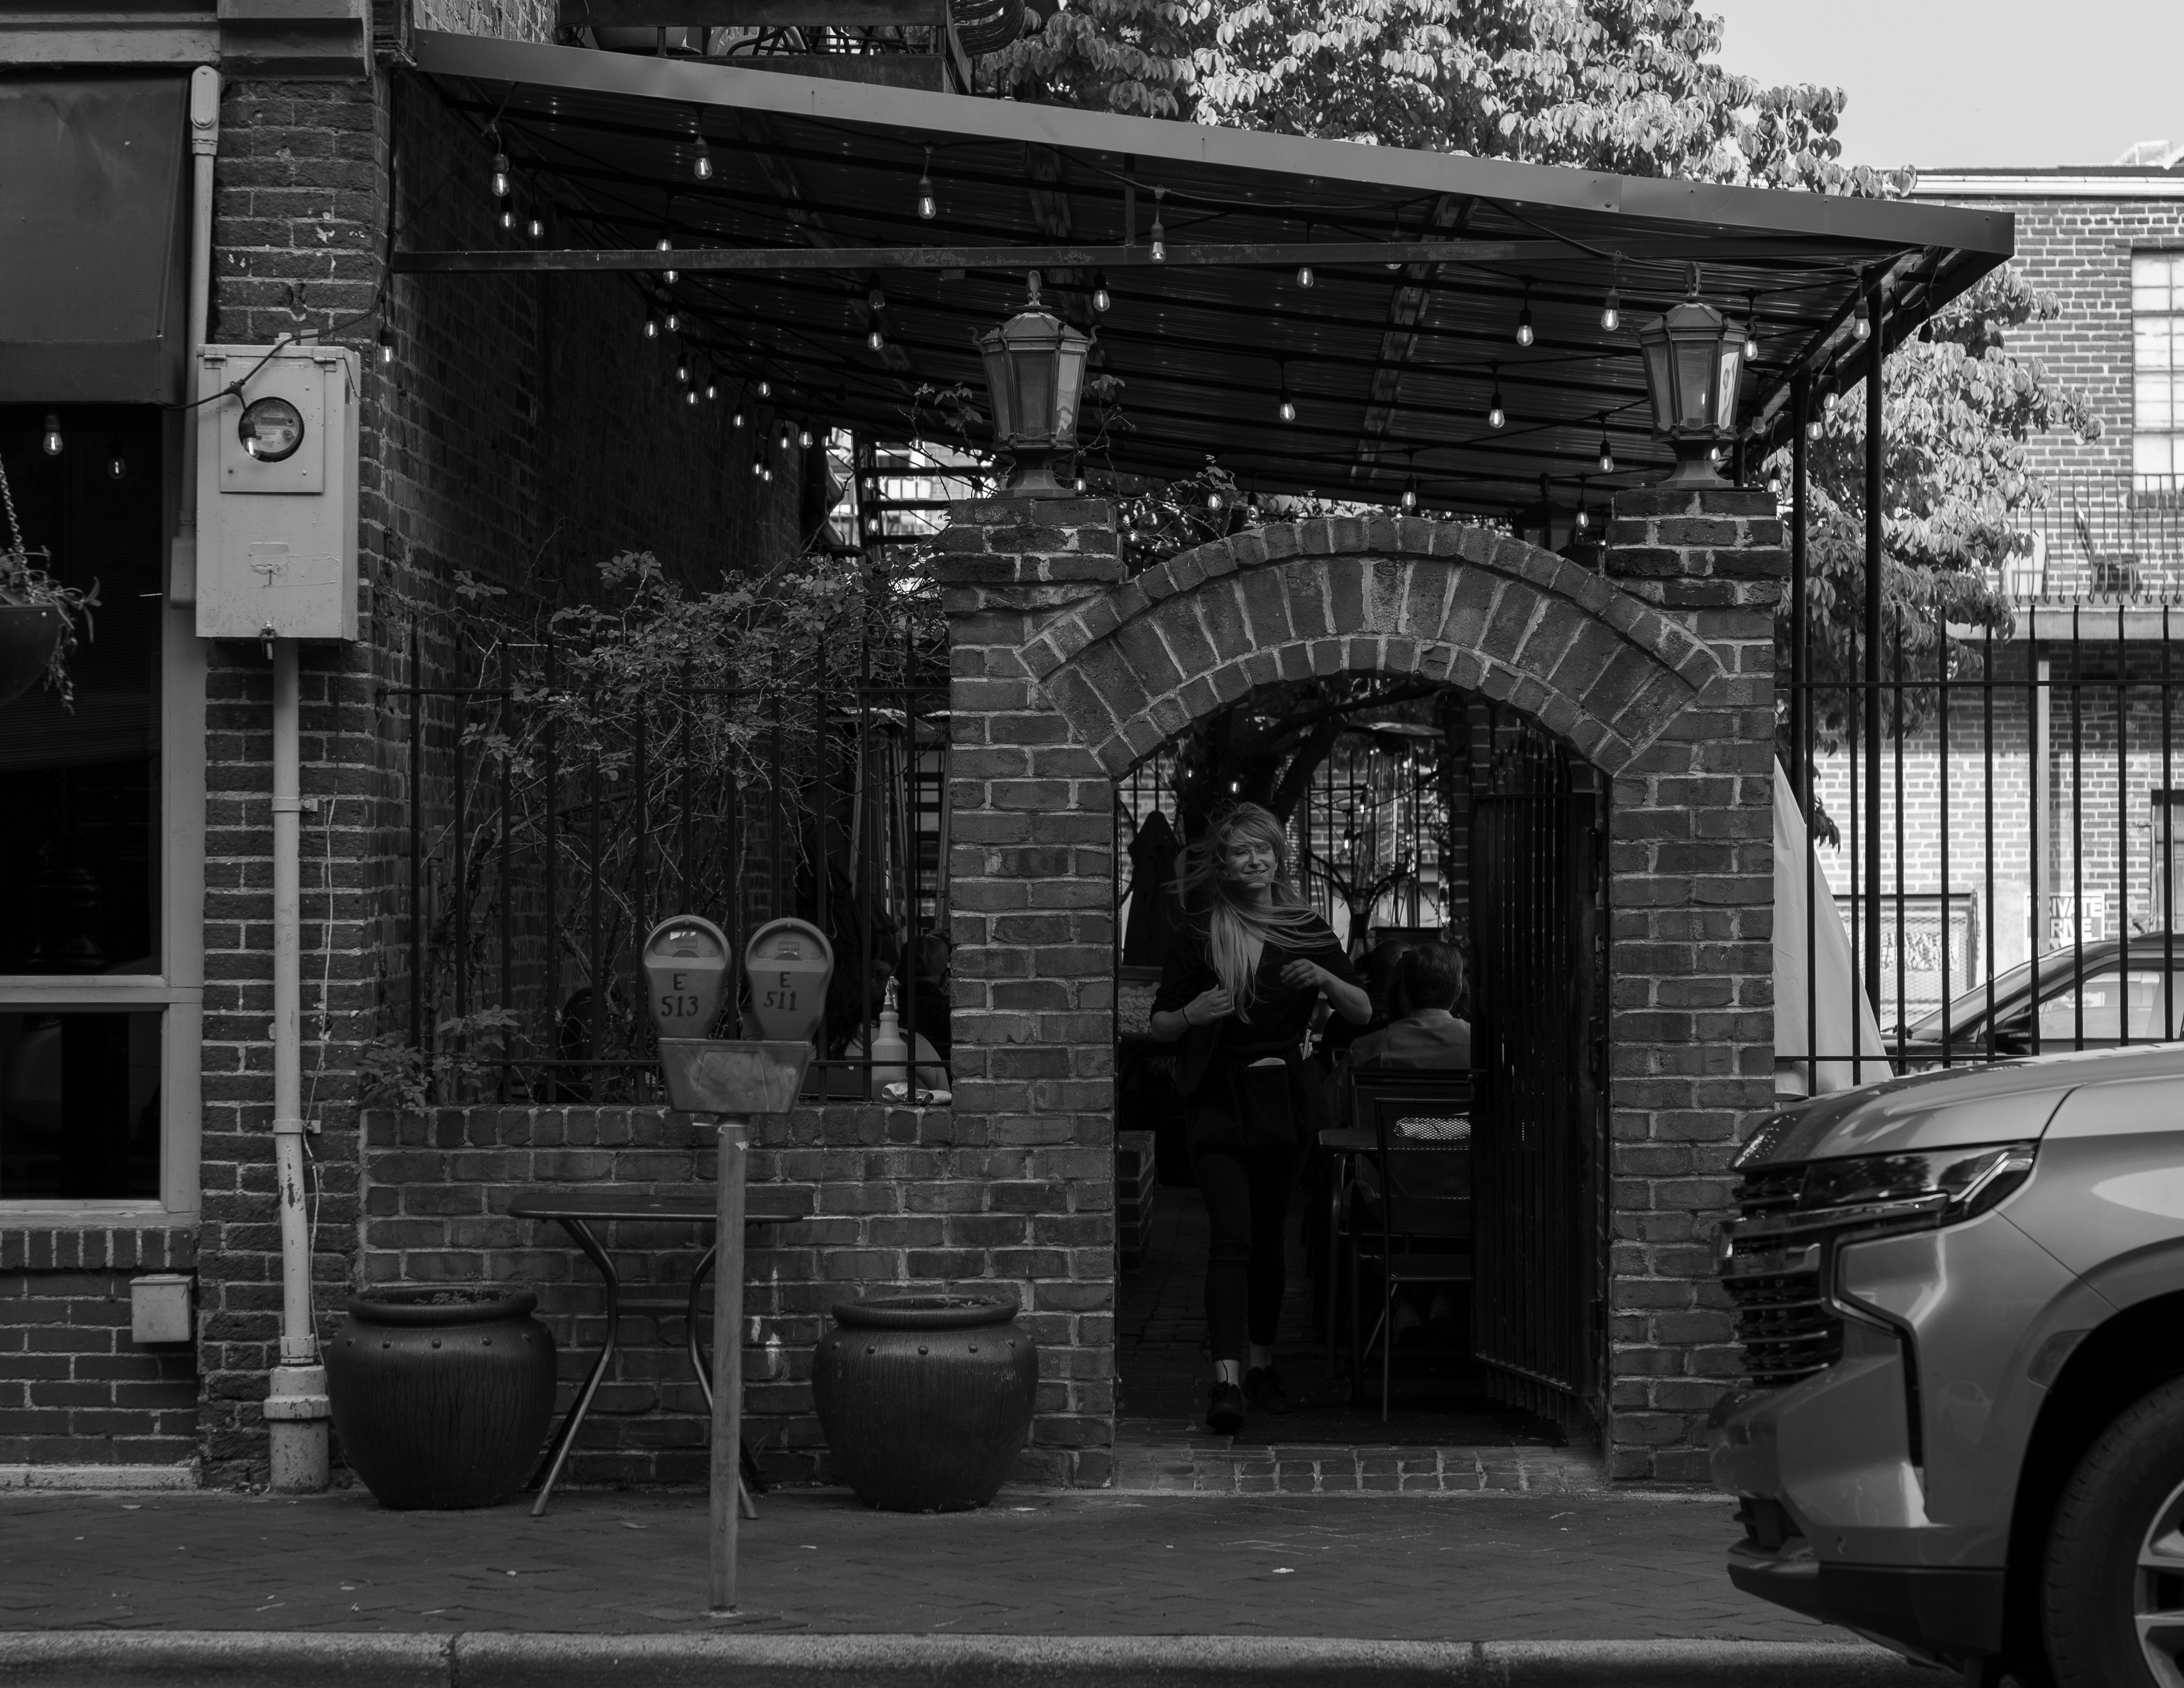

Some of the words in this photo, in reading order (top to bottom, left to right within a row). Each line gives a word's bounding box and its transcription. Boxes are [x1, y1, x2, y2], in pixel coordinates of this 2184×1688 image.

[2027, 897, 2102, 917] IVATE
[2042, 918, 2092, 938] RIVE
[673, 973, 686, 991] E
[780, 971, 792, 988] E
[661, 995, 699, 1017] 513
[763, 991, 799, 1012] 511
